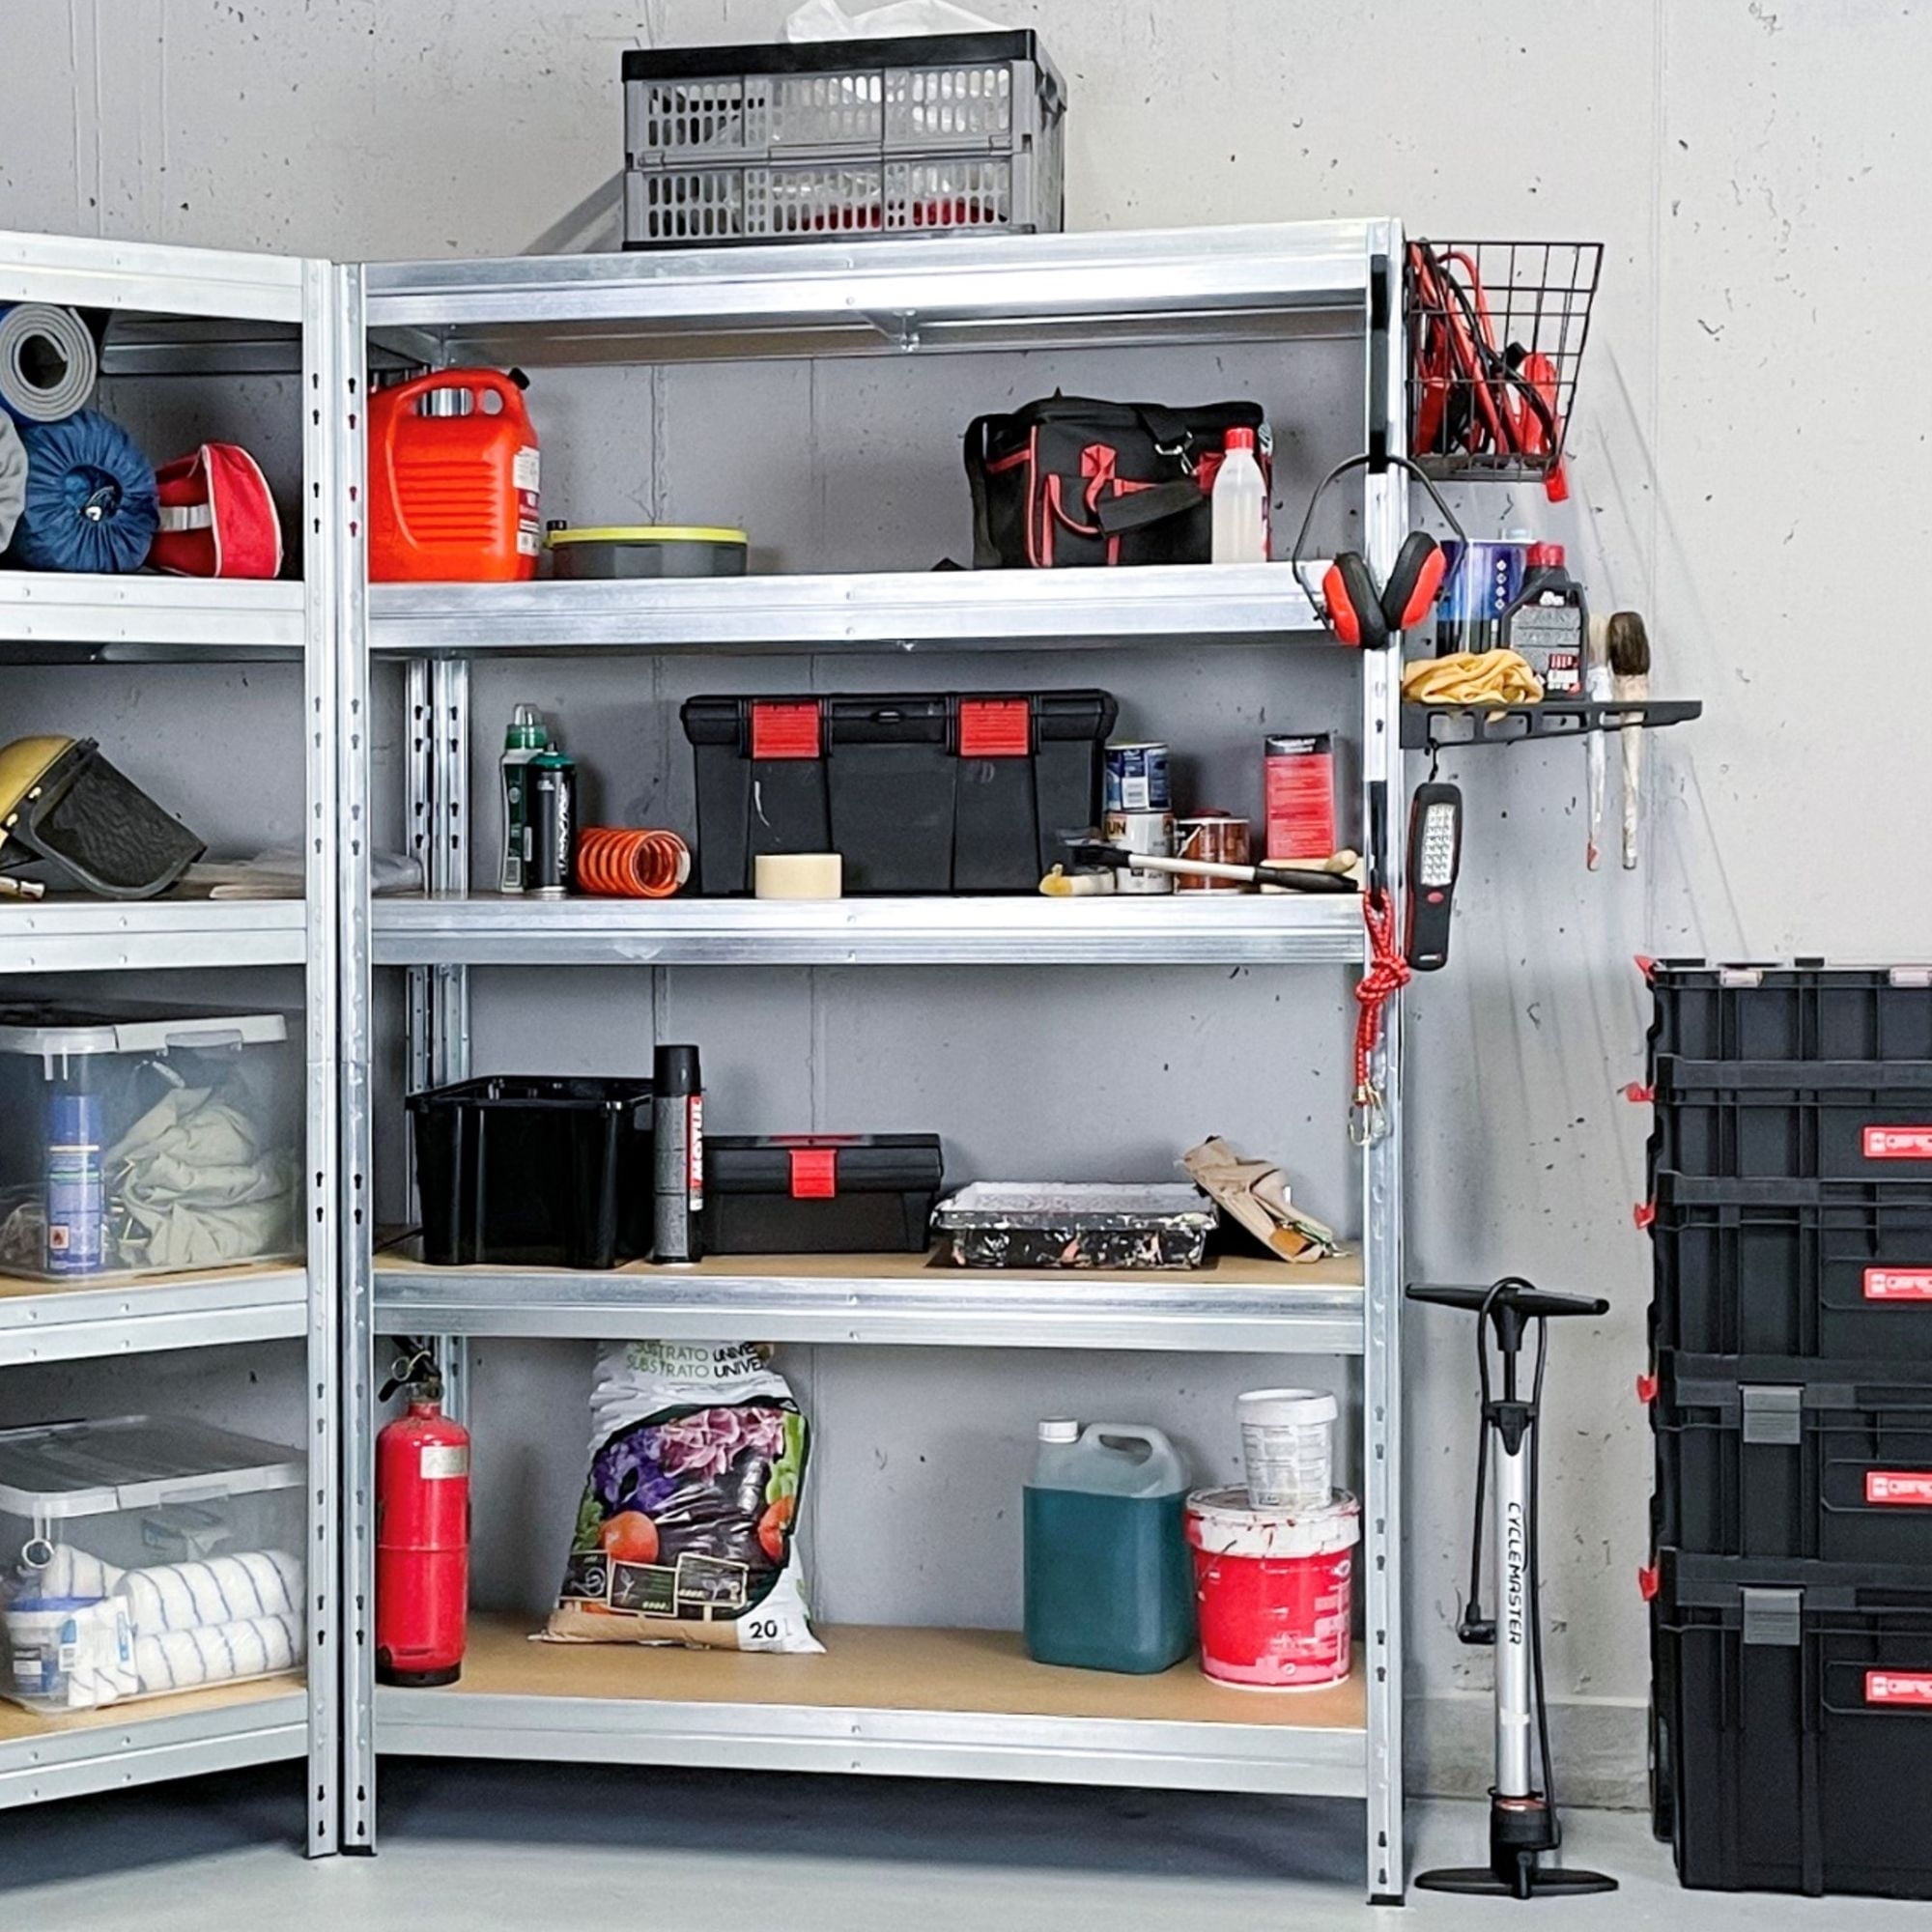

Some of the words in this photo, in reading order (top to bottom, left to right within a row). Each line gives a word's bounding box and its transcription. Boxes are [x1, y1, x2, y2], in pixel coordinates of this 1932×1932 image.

[626, 1354, 709, 1378] SUBSTRATO
[1508, 1502, 1521, 1644] CYCLEMASTER
[749, 1619, 778, 1638] 20
